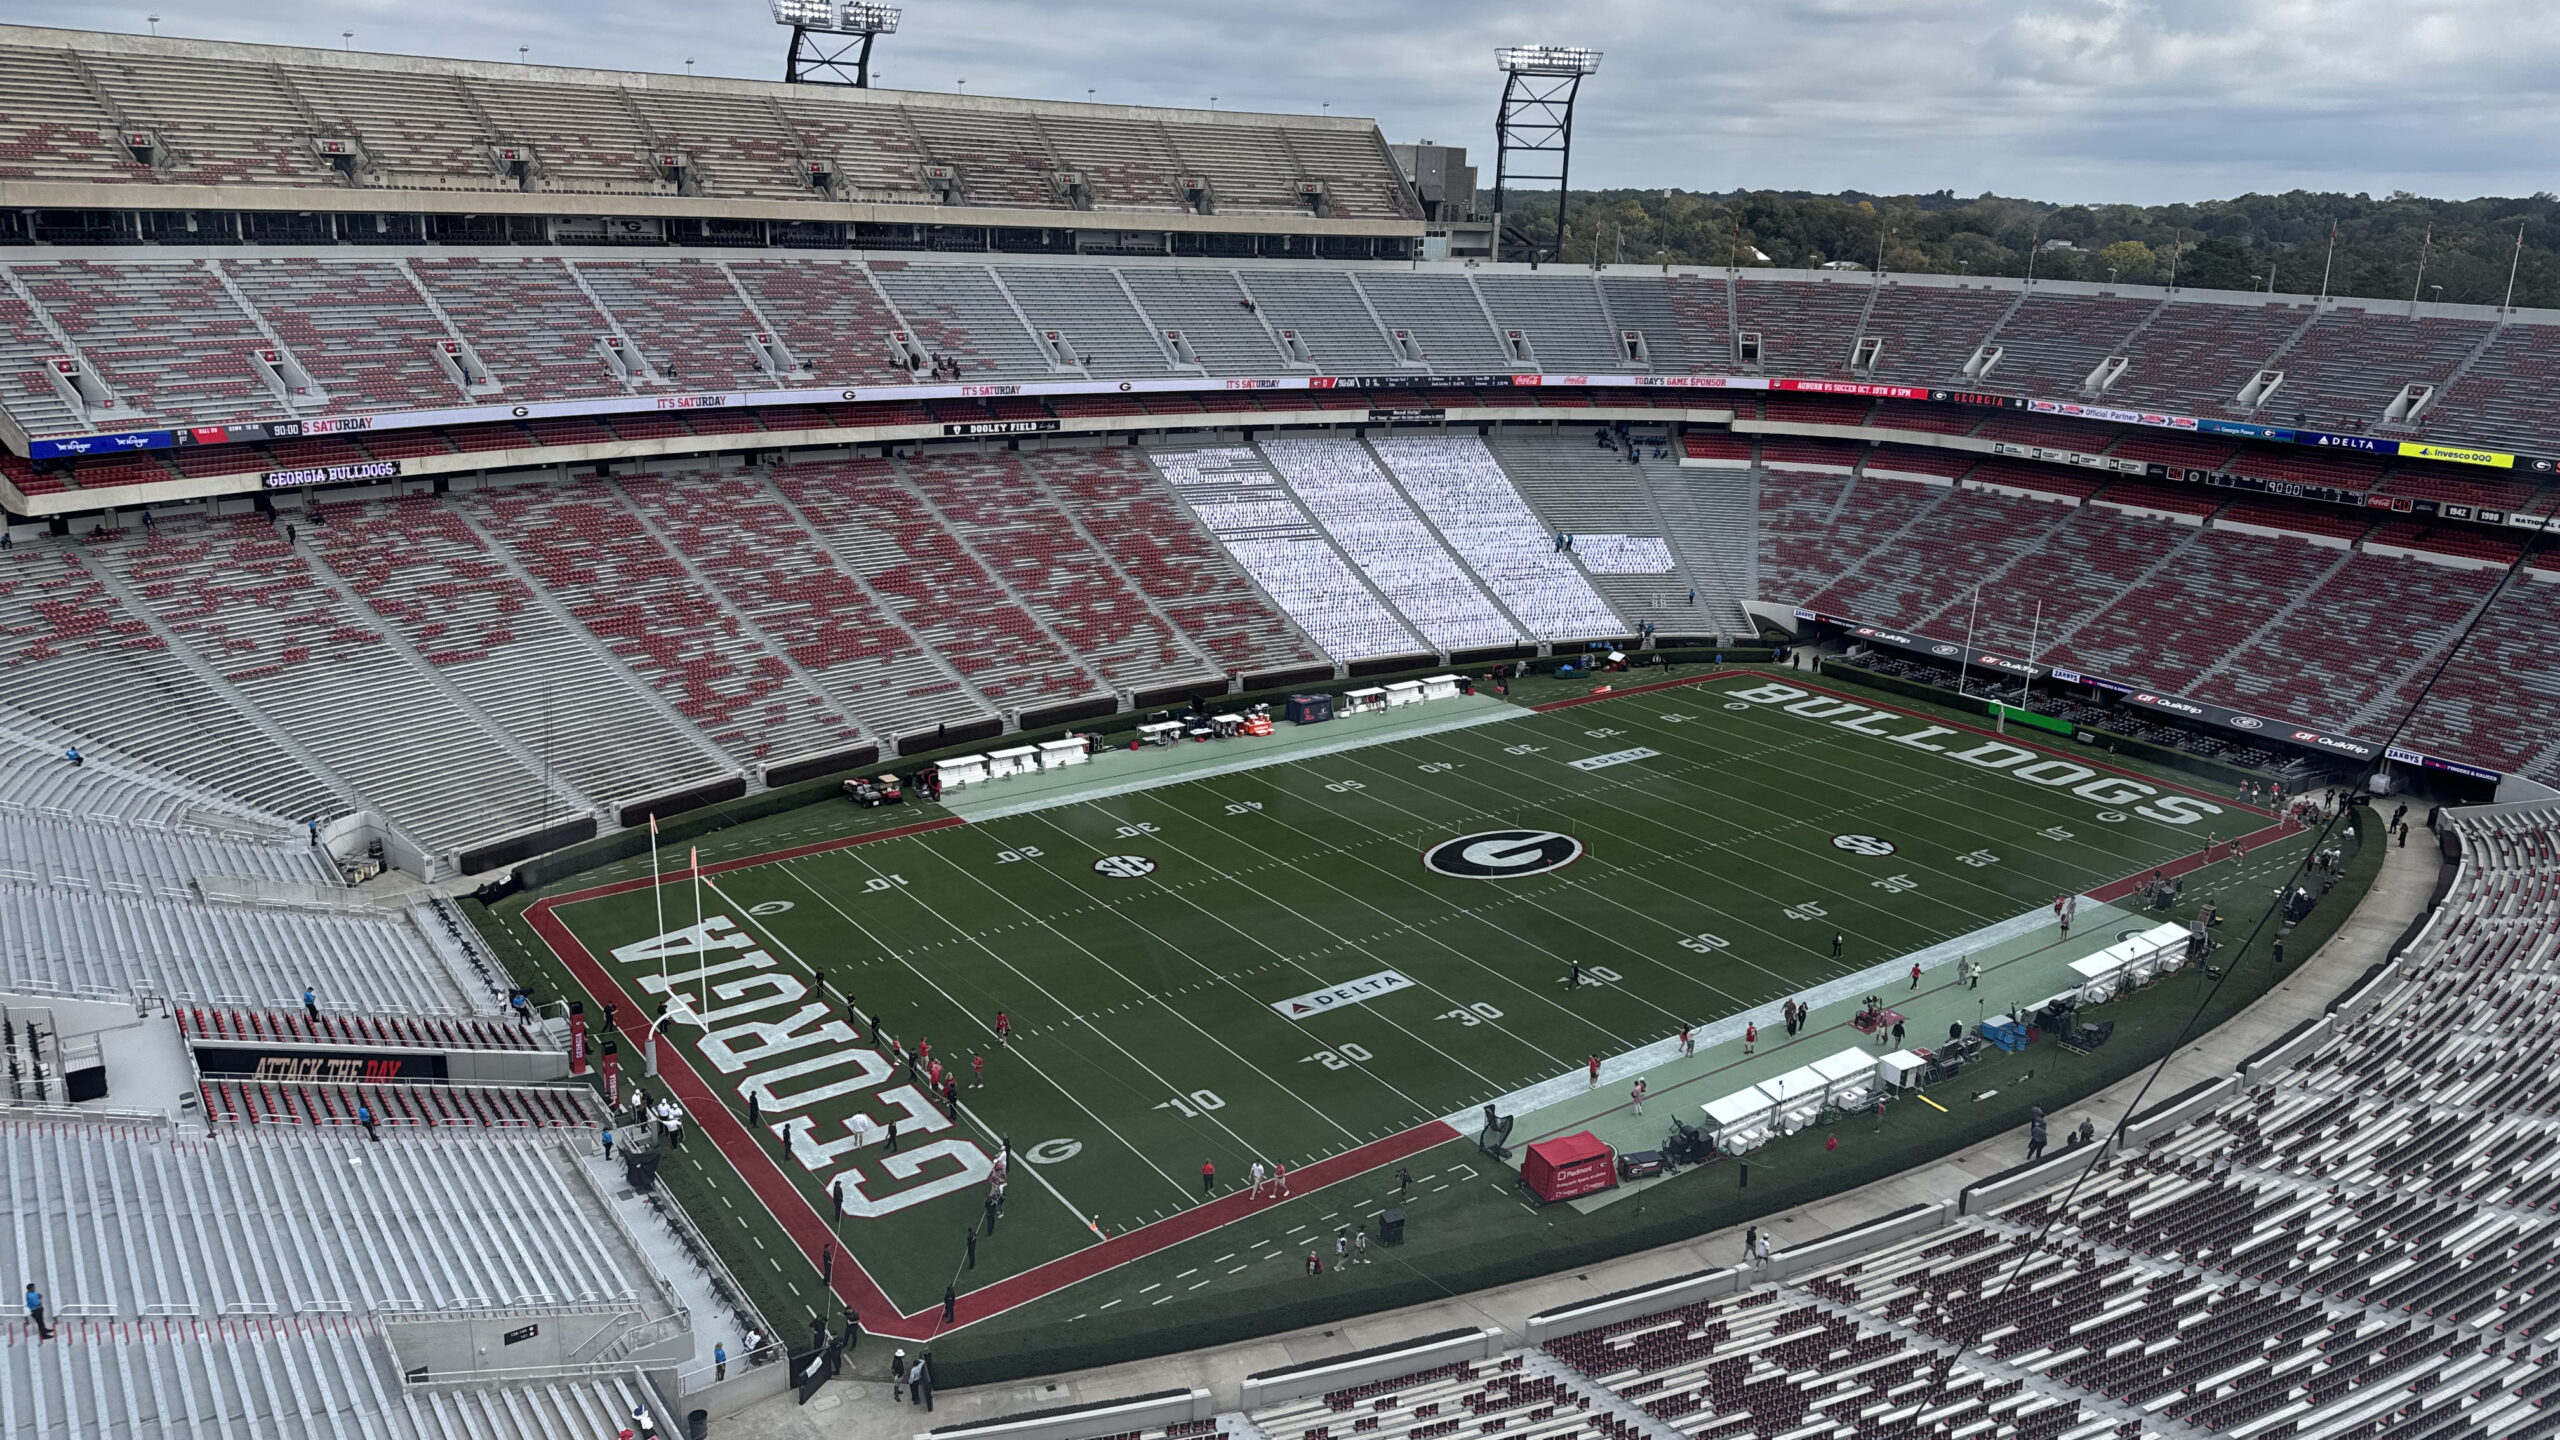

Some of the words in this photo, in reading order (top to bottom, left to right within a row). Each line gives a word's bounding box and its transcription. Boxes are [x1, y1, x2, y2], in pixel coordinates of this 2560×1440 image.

[1226, 380, 1240, 389] IT'S
[1241, 379, 1280, 388] SATURDAY
[1634, 377, 1665, 386] TODAY'S
[1666, 377, 1688, 386] GAME
[1690, 377, 1727, 387] SPONSOR
[1797, 381, 1823, 391] AUBURN
[1824, 383, 1833, 392] VS
[1833, 384, 1857, 393] SOCCER
[962, 386, 977, 396] IT'S
[979, 385, 1021, 396] SATURDAY
[657, 396, 675, 409] IT'S
[677, 395, 727, 408] SATURDAY
[1953, 392, 2004, 407] GEORGIA
[2085, 408, 2108, 418] Official
[2110, 411, 2136, 422] Partner
[274, 424, 299, 436] 90:00
[313, 417, 373, 432] SATURDAY
[970, 424, 1008, 434] DOOLEY
[1010, 422, 1037, 432] FIELD
[2221, 426, 2240, 435] Georgia
[2240, 428, 2255, 436] Power
[2332, 437, 2374, 450] DELTA
[2434, 448, 2470, 460] Invesco
[2471, 453, 2492, 463] QQQ
[269, 468, 326, 487] GEORGIA
[329, 462, 394, 481] BULLDOGS
[2269, 482, 2300, 496] 90:00
[2367, 497, 2392, 508] Coca-Cola
[2449, 507, 2467, 517] 1942
[2481, 511, 2500, 521] 1980
[2054, 669, 2079, 682] ZAXBYS
[2157, 698, 2203, 715] QuikTrip
[2295, 732, 2316, 741] QT
[2317, 737, 2369, 754] QuikTrip
[1594, 746, 1652, 765] DELTA
[1723, 682, 2223, 825] BULLDOGS
[2387, 750, 2420, 764] ZAXBYS
[1124, 822, 1161, 836] 30
[2036, 827, 2075, 842] 10
[1832, 833, 1897, 856] SEC
[1005, 845, 1045, 863] 20
[1955, 850, 2000, 868] 20
[1093, 855, 1156, 878] SEC
[865, 873, 910, 892] 10
[1872, 875, 1919, 894] 30
[1784, 902, 1828, 922] 40
[1677, 933, 1730, 954] 50
[1577, 965, 1623, 987] 40
[1313, 971, 1404, 1007] DELTA
[1449, 1002, 1504, 1027] 30
[1313, 1042, 1374, 1070] 20
[254, 1057, 324, 1082] ATTACK
[326, 1059, 363, 1083] THE
[364, 1060, 401, 1084] DAY
[609, 914, 996, 1219] GEORGIA
[1169, 1088, 1226, 1118] 10
[1566, 1165, 1593, 1178] Piedmont
